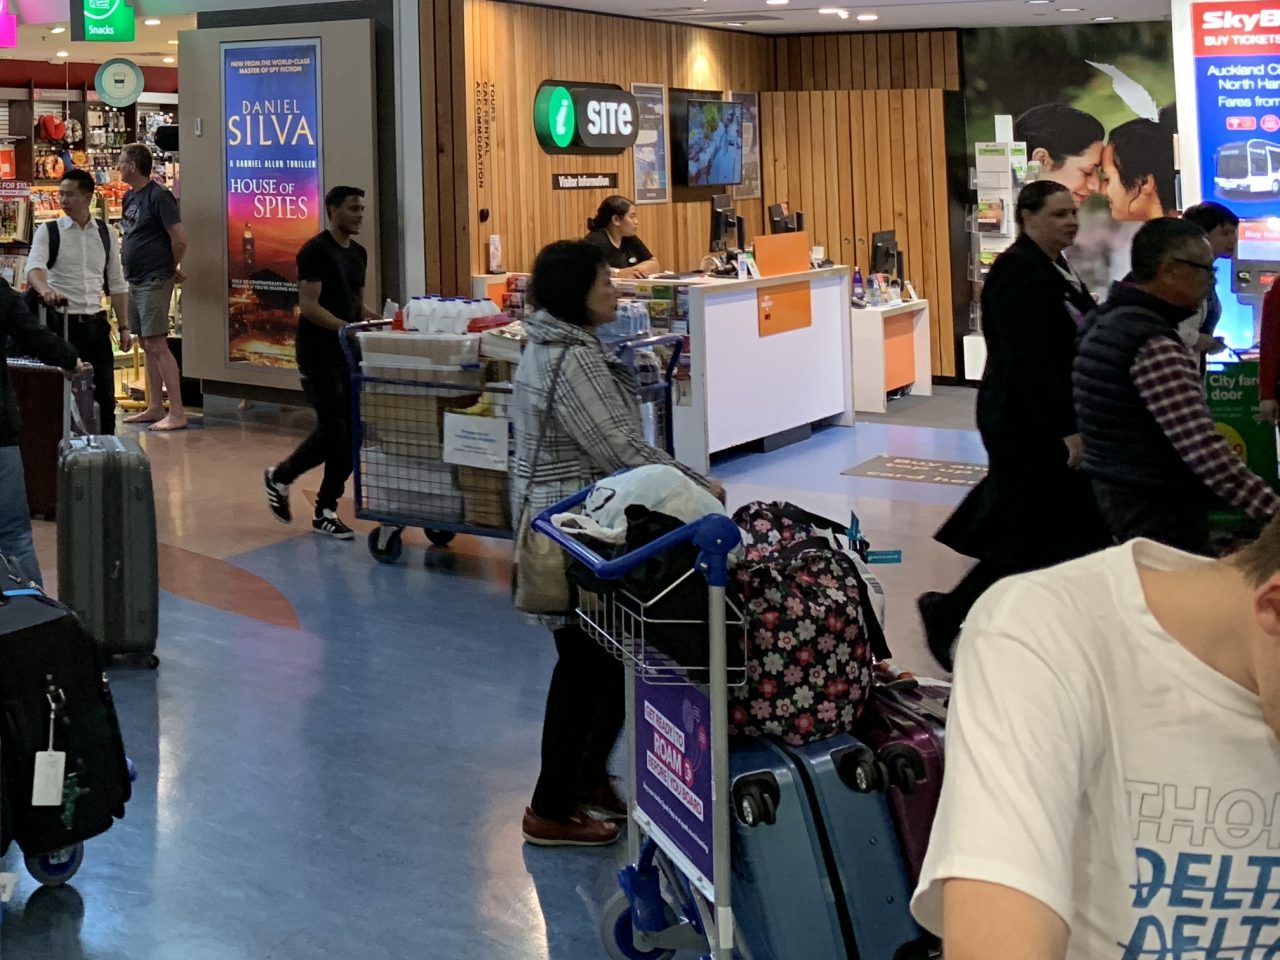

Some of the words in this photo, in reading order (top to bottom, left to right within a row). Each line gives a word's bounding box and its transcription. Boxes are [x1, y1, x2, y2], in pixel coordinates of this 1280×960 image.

[88, 25, 115, 35] Snacks
[1204, 35, 1229, 46] BUY
[272, 58, 310, 66] WORLD-CLASS
[1207, 64, 1265, 76] Auckland
[1218, 78, 1254, 90] North
[242, 99, 300, 114] DANIEL
[1218, 95, 1252, 107] Fares
[228, 115, 316, 146] SILVA
[475, 80, 484, 189] ACCOMMODATION
[229, 160, 234, 168] A
[236, 160, 262, 168] GABRIEL
[264, 160, 284, 168] ALLON
[287, 160, 317, 168] THRILLER
[230, 179, 277, 194] HOUSE
[279, 182, 295, 194] OF
[558, 175, 578, 188] Visitor
[578, 175, 610, 187] Information
[253, 195, 308, 220] SPIES
[1245, 230, 1261, 239] Buy
[1210, 375, 1236, 388] City
[1211, 390, 1243, 399] door
[893, 458, 942, 467] Buy
[646, 704, 656, 722] GET
[656, 711, 674, 736] READY
[674, 729, 684, 749] TO
[654, 731, 683, 778] ROAM
[648, 753, 667, 783] BEFORE
[669, 772, 681, 796] YOU
[681, 781, 702, 817] BOARD
